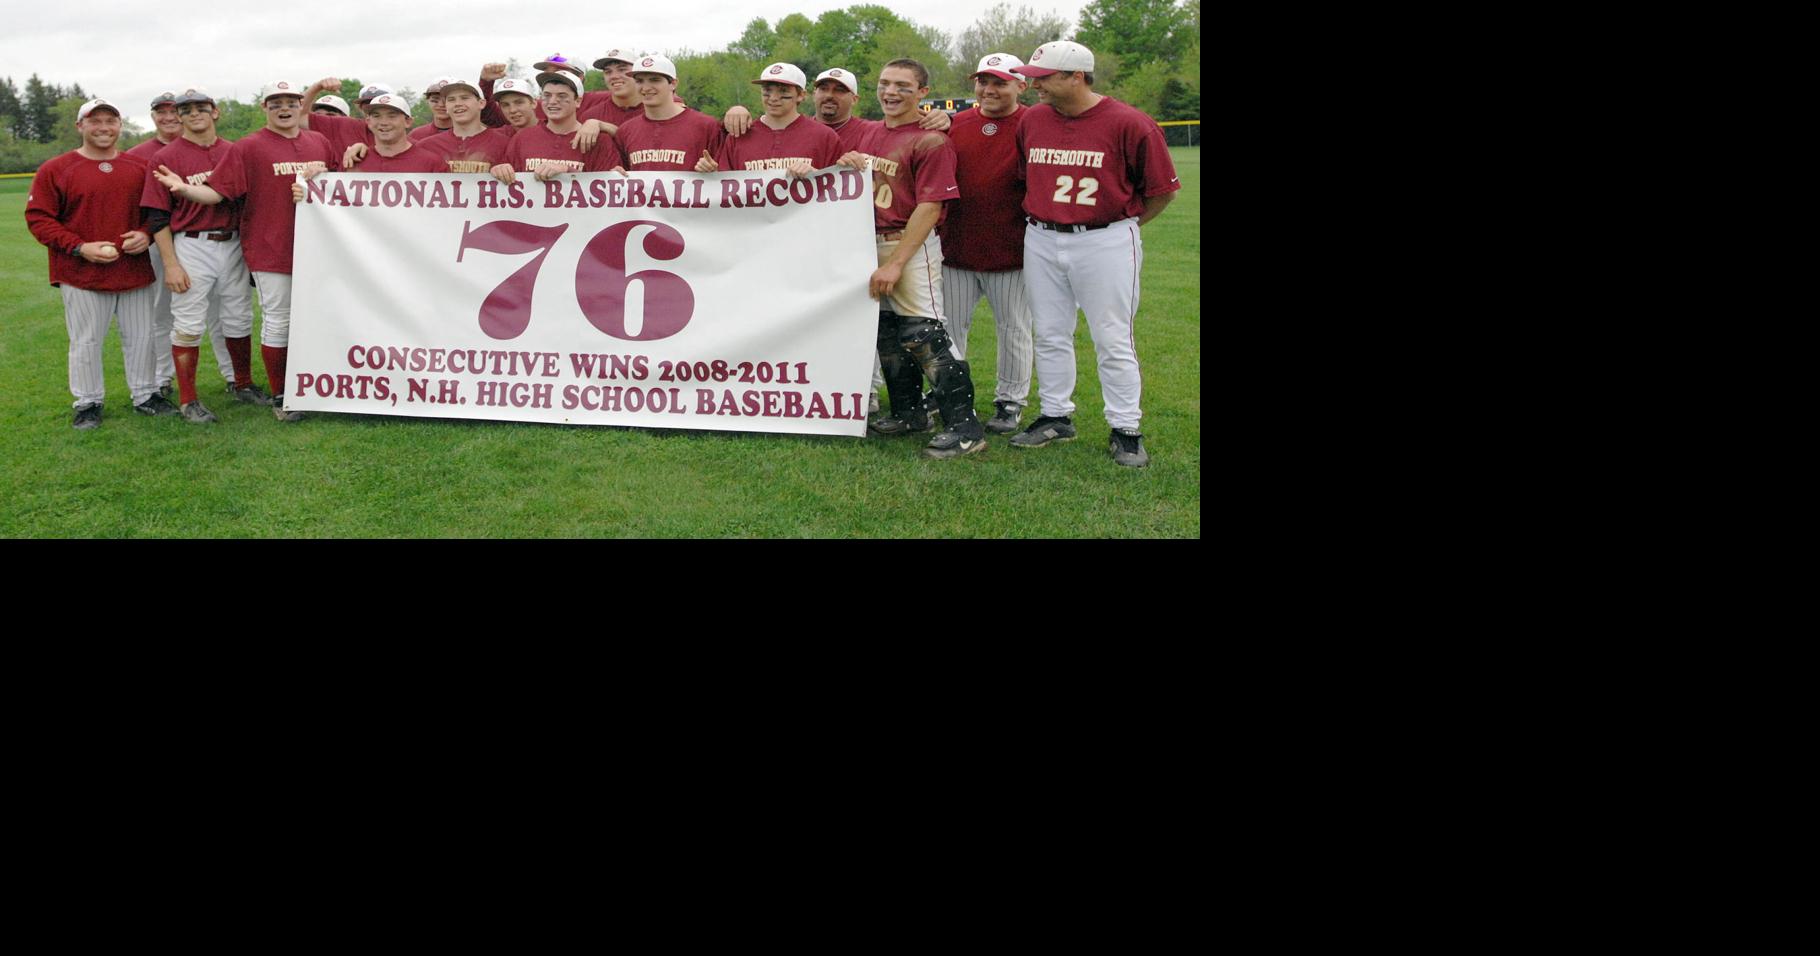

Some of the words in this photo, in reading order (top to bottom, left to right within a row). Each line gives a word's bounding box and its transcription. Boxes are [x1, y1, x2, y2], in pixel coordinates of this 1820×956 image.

[1028, 147, 1105, 168] PORTSMOUTH
[306, 178, 468, 209] NATIONAL
[478, 179, 534, 208] H.S.
[543, 178, 710, 209] BASEBALL
[719, 168, 865, 209] RECORD
[1052, 175, 1099, 206] 22
[456, 219, 696, 342] 76
[347, 344, 560, 378] CONSECUTIVE
[569, 352, 649, 381] WINS
[657, 359, 810, 385] 2008-2011
[295, 372, 397, 407] PORTS,
[406, 377, 467, 405] N.H.
[475, 381, 553, 409] HIGH
[562, 384, 686, 414] SCHOOL
